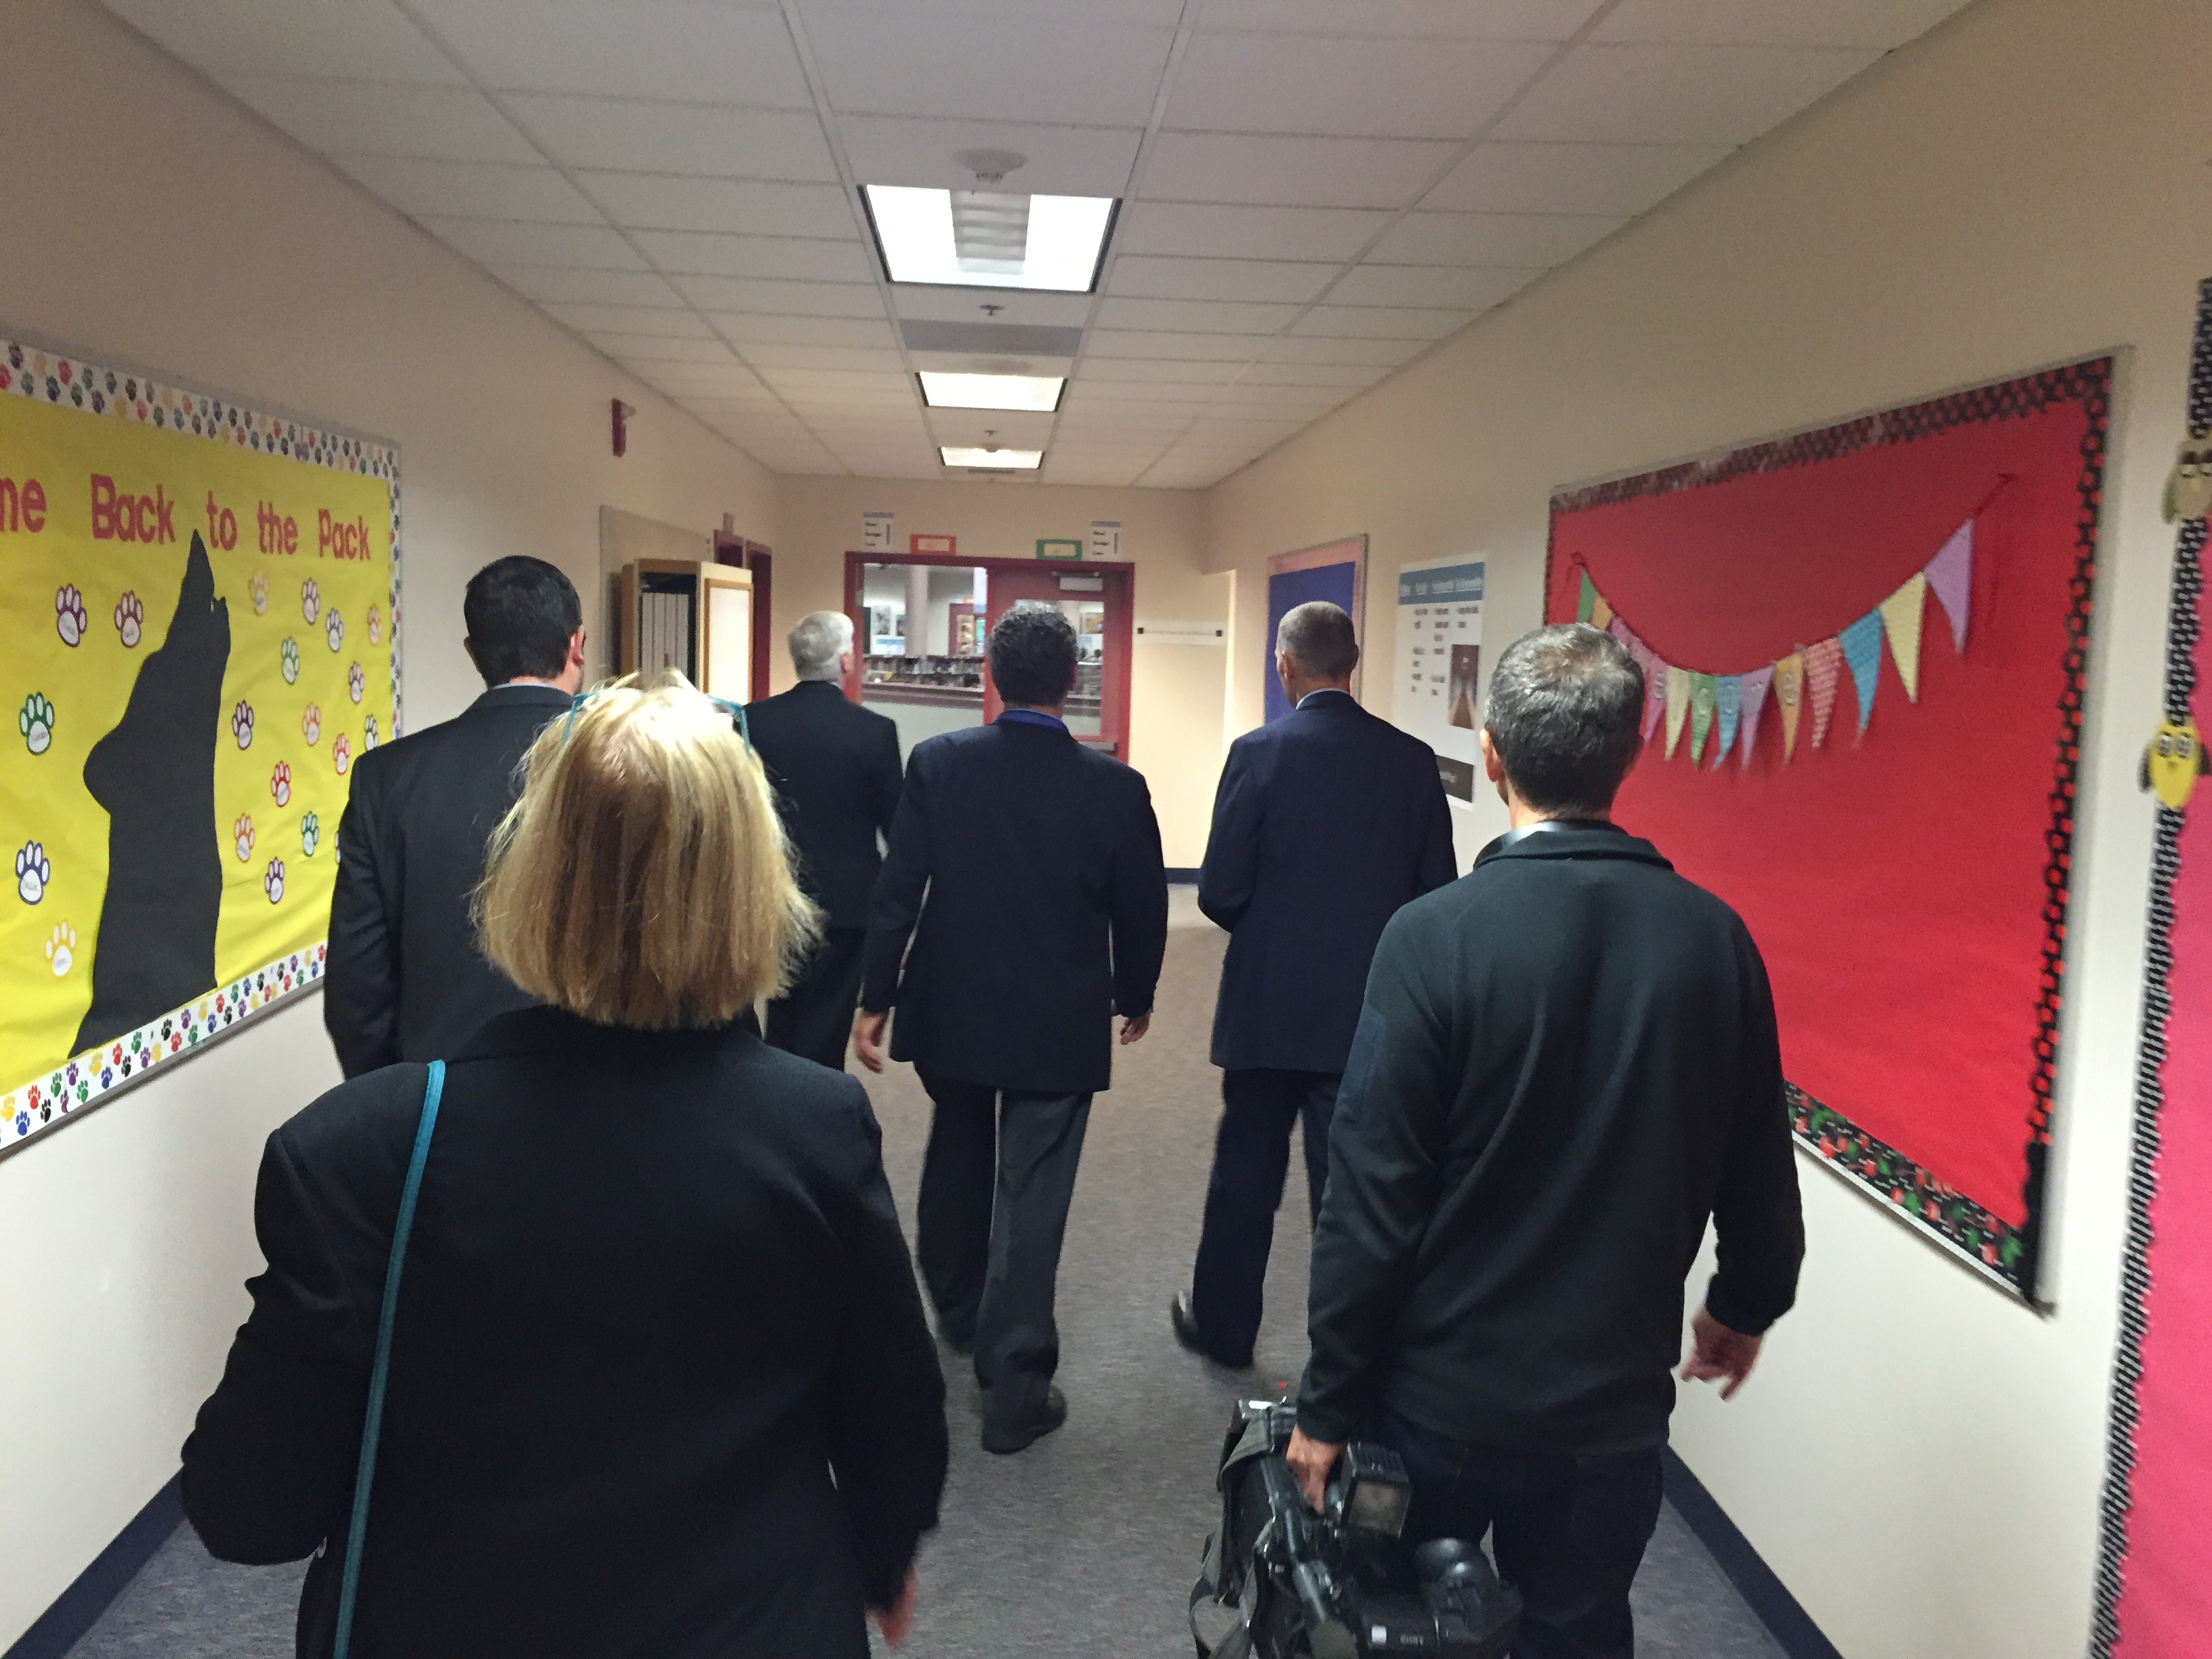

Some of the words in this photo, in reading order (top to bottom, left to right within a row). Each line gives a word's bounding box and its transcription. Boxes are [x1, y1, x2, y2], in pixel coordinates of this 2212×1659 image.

[91, 473, 176, 544] Back
[206, 490, 237, 551] to
[258, 499, 298, 555] the
[319, 508, 371, 560] Pack
